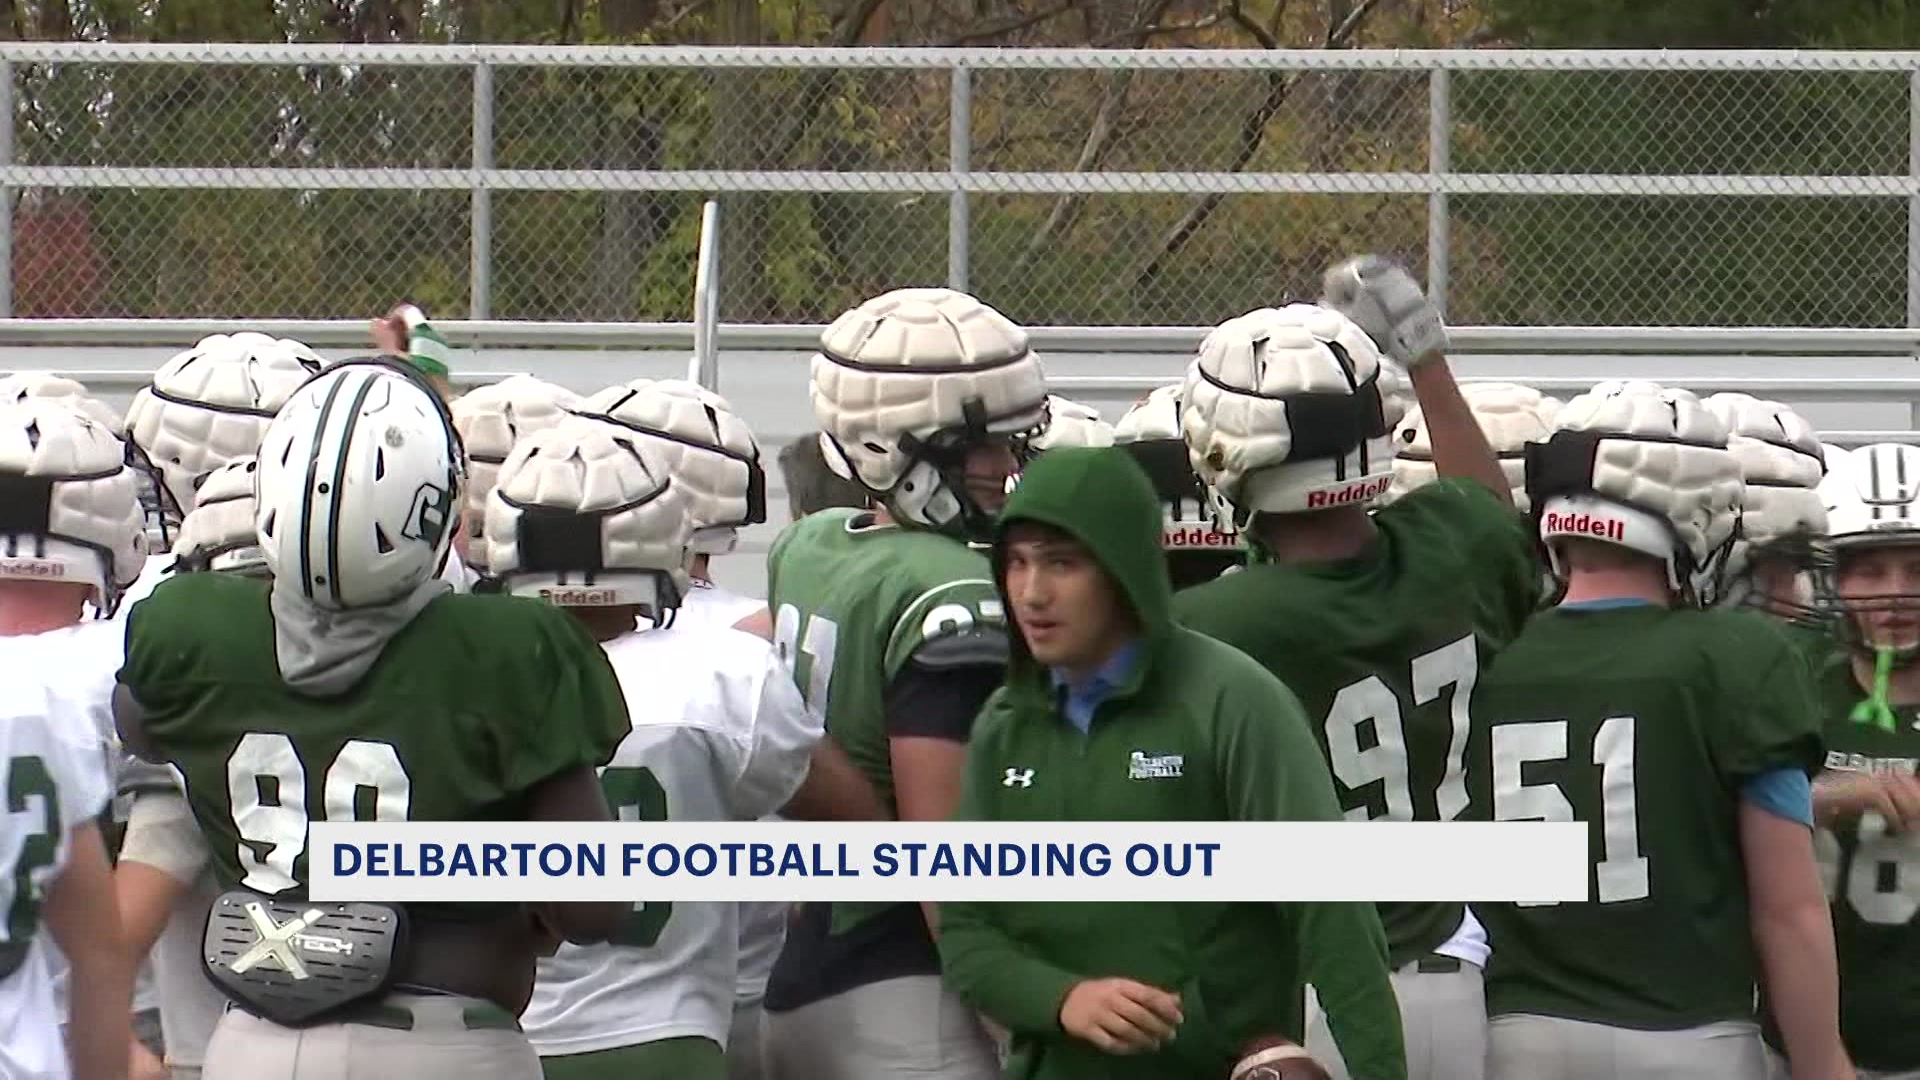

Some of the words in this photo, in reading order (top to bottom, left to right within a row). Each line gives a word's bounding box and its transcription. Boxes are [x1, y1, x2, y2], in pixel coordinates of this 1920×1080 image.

[1308, 478, 1392, 508] Riddell
[1163, 526, 1238, 546] iddell
[1547, 513, 1624, 541] Riddell
[1324, 632, 1480, 822] 97
[1491, 716, 1650, 908] 51
